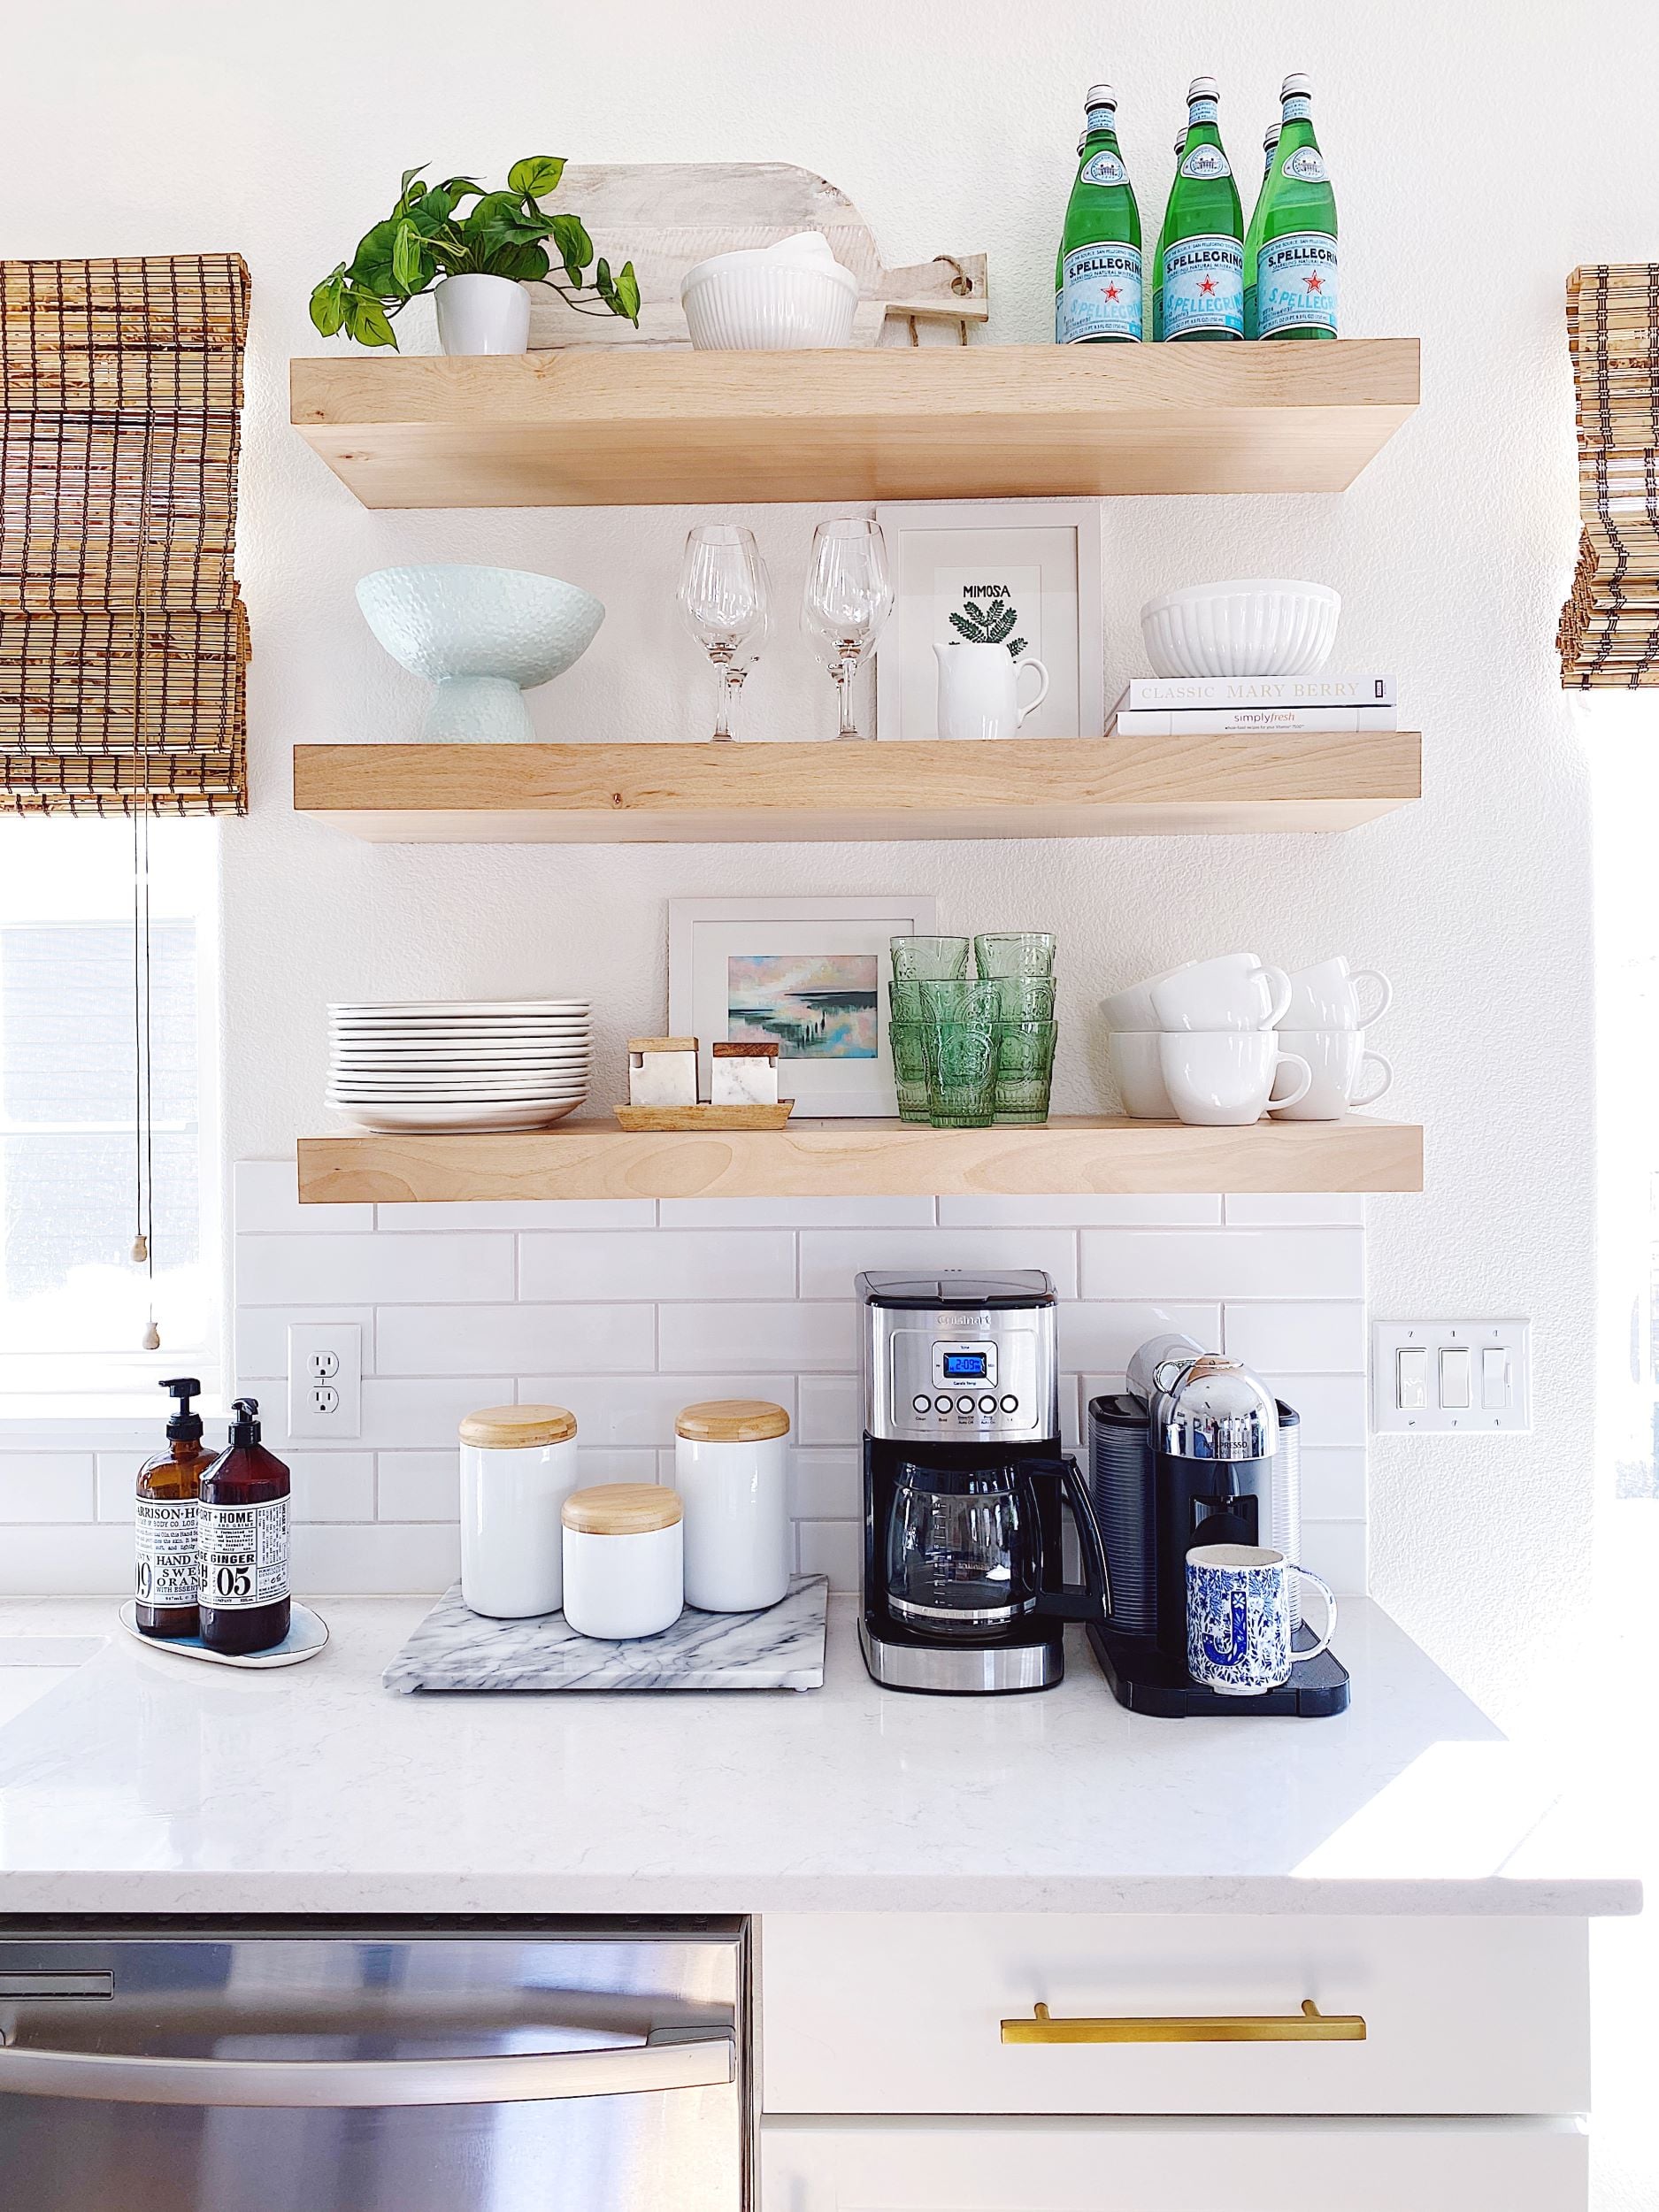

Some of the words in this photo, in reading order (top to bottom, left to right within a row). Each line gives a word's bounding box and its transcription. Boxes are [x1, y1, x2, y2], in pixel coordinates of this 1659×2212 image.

[963, 585, 1011, 598] MIMOSA
[1141, 686, 1216, 700] CLASSIC
[1227, 684, 1285, 699] MARY
[1294, 682, 1360, 698] BERRY
[219, 1512, 254, 1524] HOME
[156, 1555, 191, 1566] HAND
[211, 1553, 255, 1565] GINGER
[162, 1567, 197, 1578] SWE
[157, 1577, 199, 1587] ORAN
[216, 1566, 251, 1596] 05
[1202, 1591, 1248, 1667] J
